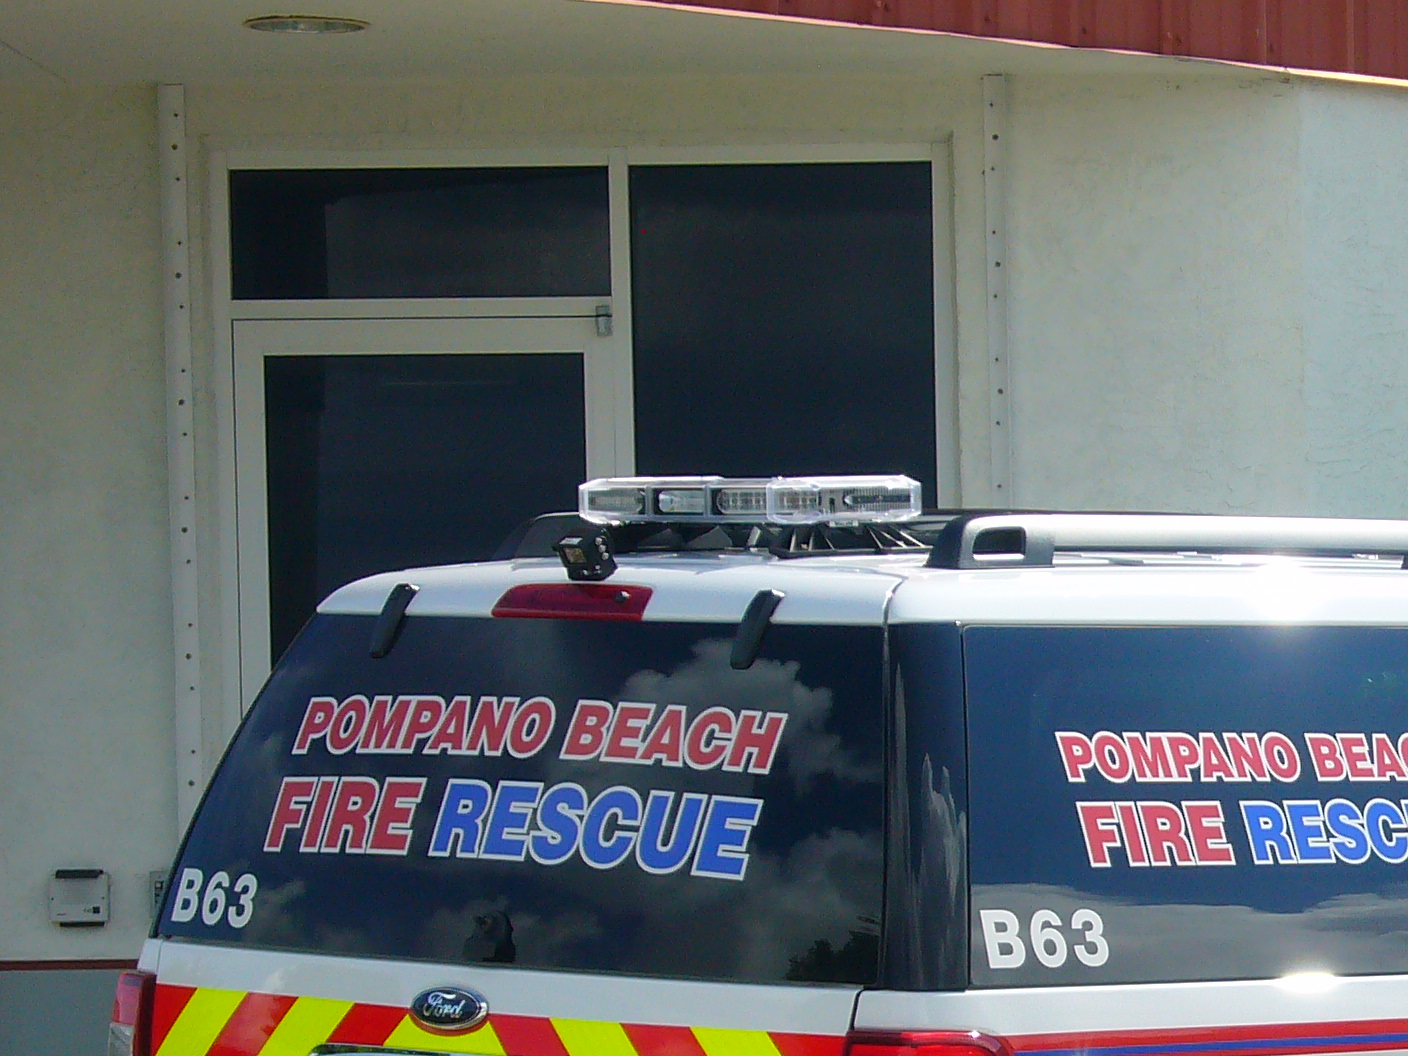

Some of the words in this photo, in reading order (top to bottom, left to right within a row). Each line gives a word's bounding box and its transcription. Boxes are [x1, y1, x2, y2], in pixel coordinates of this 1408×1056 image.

[293, 695, 556, 758] POMPANO
[559, 699, 788, 775] BEACH
[1054, 731, 1301, 783] POMPANO
[264, 776, 427, 856] FIRE
[428, 778, 764, 881] RESCUE
[1075, 799, 1236, 868] FIRE
[171, 868, 258, 929] B63
[979, 909, 1110, 969] B63
[424, 992, 466, 1018] Ford
